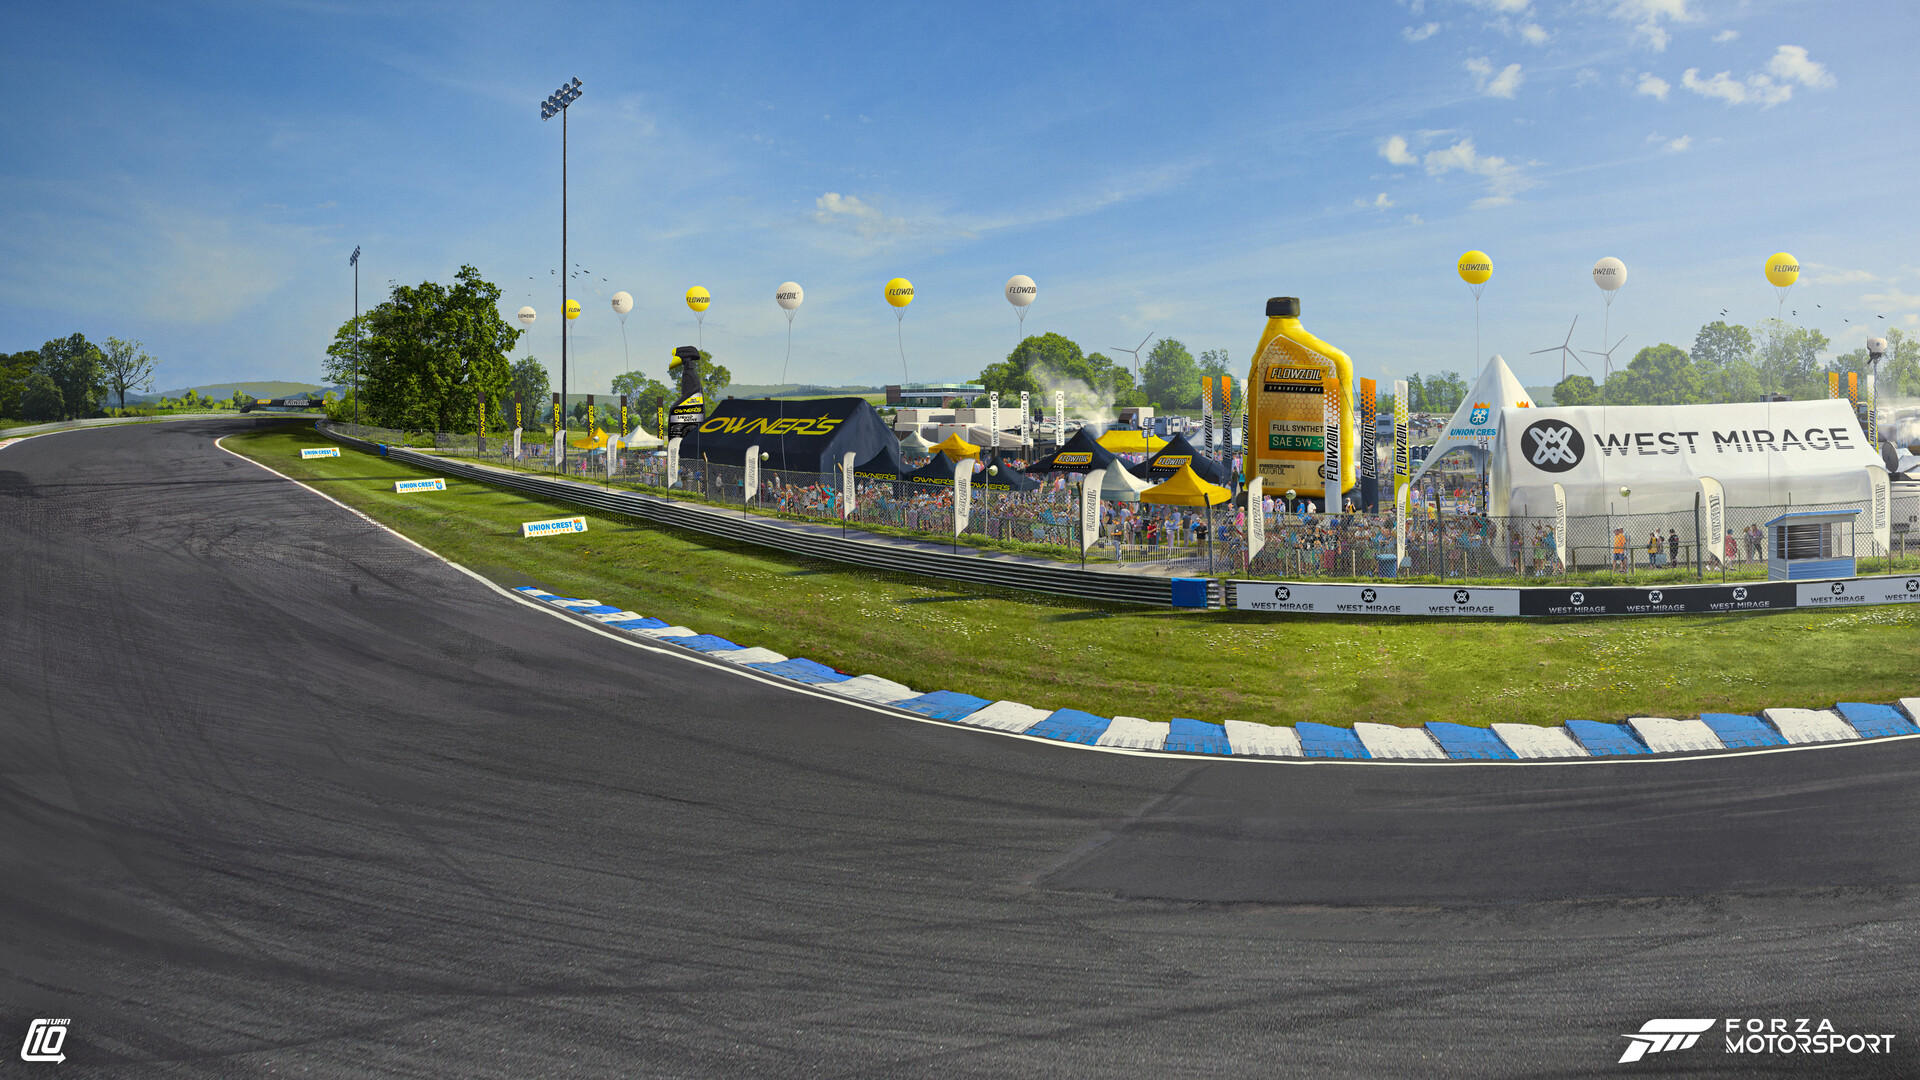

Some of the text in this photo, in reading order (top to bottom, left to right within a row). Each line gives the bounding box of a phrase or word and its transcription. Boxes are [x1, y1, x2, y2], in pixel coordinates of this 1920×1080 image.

[1459, 263, 1491, 271] FLOWZOIL
[1271, 368, 1322, 380] FLOWZOIL
[699, 413, 844, 435] OWNER'S
[1272, 424, 1290, 432] FULL
[1204, 414, 1212, 459] FLOWZOIL
[1223, 413, 1232, 460] FLOWZOIL
[1450, 428, 1476, 436] UNION
[1272, 437, 1292, 446] SAE
[1594, 428, 1855, 456] WEST MIRAGE
[1326, 424, 1338, 482] FLOWZOIL
[1362, 422, 1376, 479] FLOWZOIL
[1396, 422, 1408, 476] FLOWZOIL
[1058, 454, 1088, 462] FLOWZOIL
[854, 472, 896, 480] OWNER'S
[913, 476, 954, 485] OWNER'S
[970, 482, 1010, 491] OWNER'S
[1086, 489, 1096, 532] FLOWZOIL
[1253, 495, 1263, 542] FLOWZOIL
[528, 524, 550, 532] UNION
[552, 522, 572, 530] CREST
[1251, 602, 1277, 610] WEST
[1337, 604, 1363, 612] WEST
[1710, 602, 1734, 610] WEST
